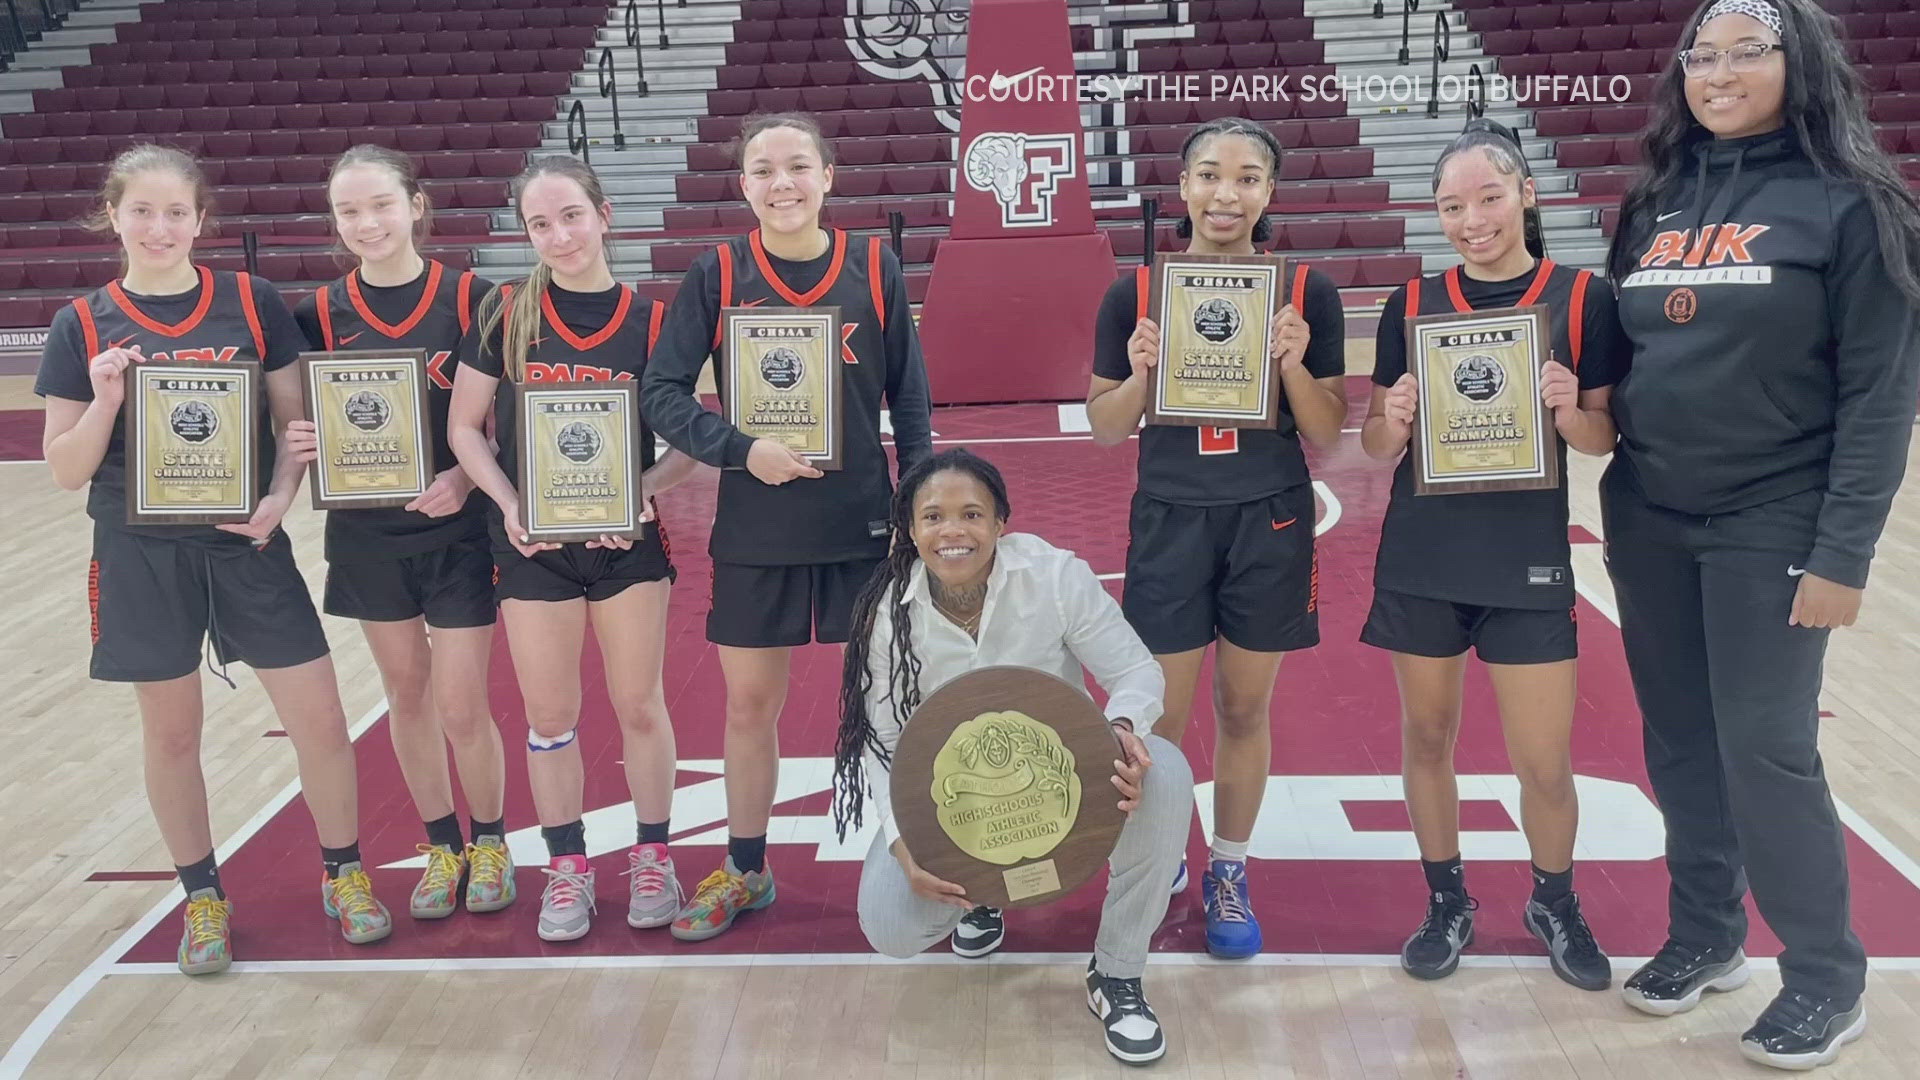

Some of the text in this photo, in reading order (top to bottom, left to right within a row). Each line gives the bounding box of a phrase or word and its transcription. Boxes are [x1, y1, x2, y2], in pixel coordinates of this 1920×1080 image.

[1192, 277, 1245, 287] CHSAA
[757, 328, 805, 337] CHSAA
[1448, 332, 1505, 346] CHSAA
[0, 333, 49, 346] RDHAM
[1184, 353, 1244, 368] STATE
[339, 372, 390, 381] CHSAA
[1174, 368, 1253, 382] CHAMPIONS
[167, 381, 220, 391] CHSAA
[553, 402, 603, 412] CHSAA
[754, 400, 809, 413] STATE
[746, 414, 817, 425] CHAMPIONS
[1448, 411, 1514, 429] STATE
[1439, 428, 1525, 444] CHAMPIONS
[342, 440, 398, 455] STATE
[164, 452, 225, 467] STATE
[333, 454, 408, 466] CHAMPIONS
[154, 468, 234, 479] CHAMPIONS
[552, 472, 608, 486] STATE
[543, 486, 617, 498] CHAMPIONS
[950, 793, 1044, 826] HIGH SCHOOLS
[987, 810, 1041, 834] ATHLETIC
[981, 821, 1059, 850] ASSOCIATION
